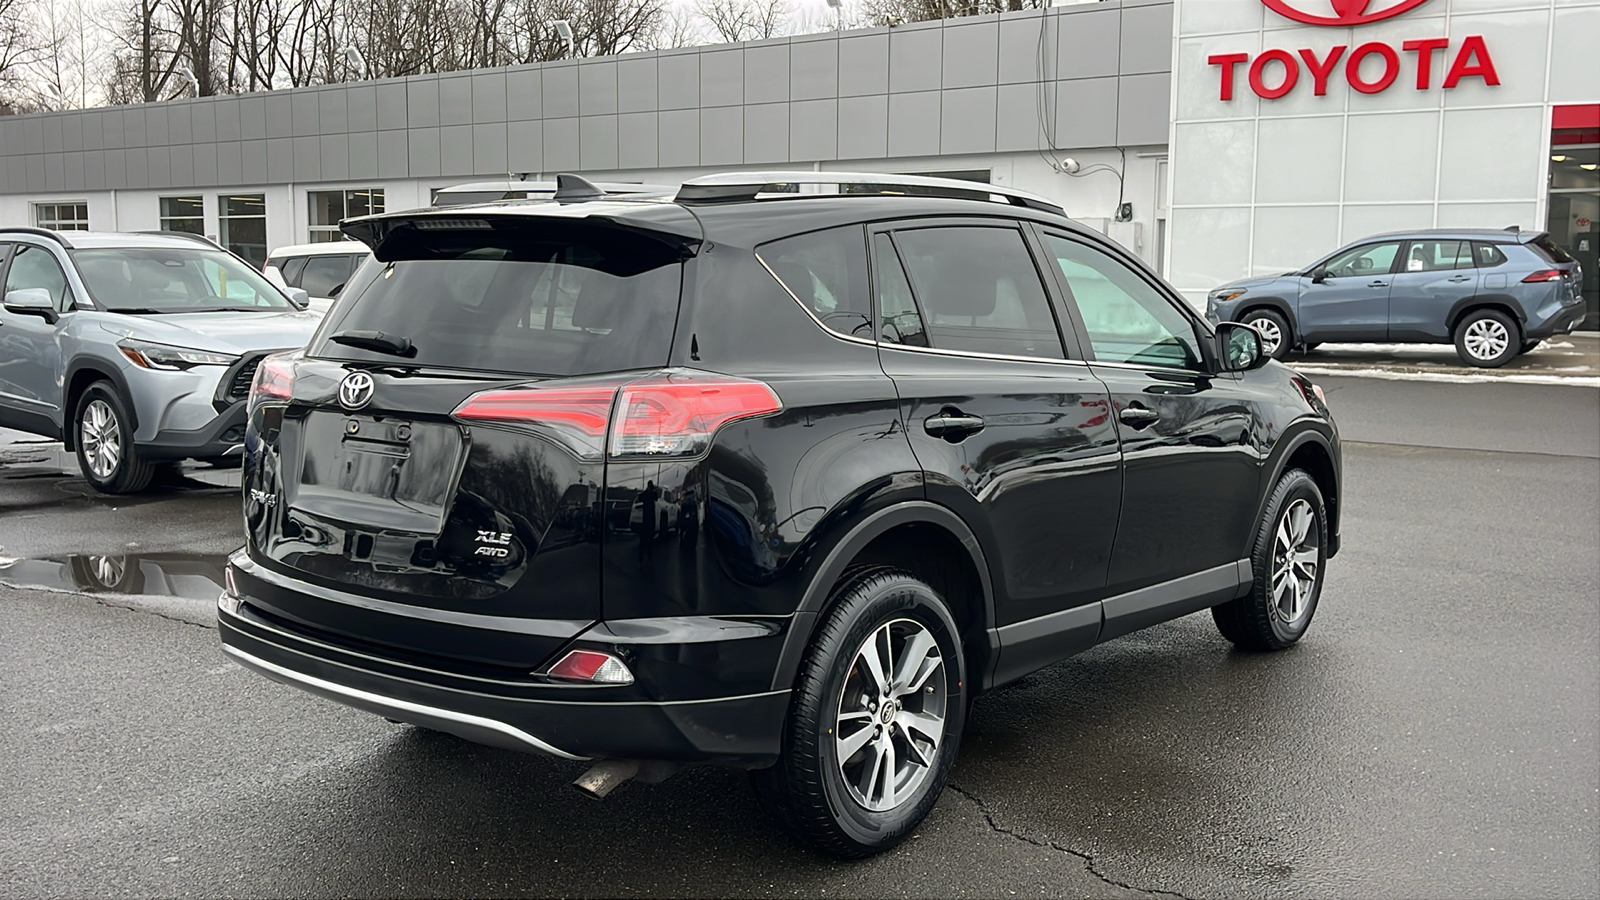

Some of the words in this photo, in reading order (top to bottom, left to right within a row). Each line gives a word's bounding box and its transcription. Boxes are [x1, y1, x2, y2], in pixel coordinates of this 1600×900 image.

[1208, 35, 1500, 101] TOYOTA
[474, 529, 513, 546] XLE
[473, 546, 509, 558] AWD
